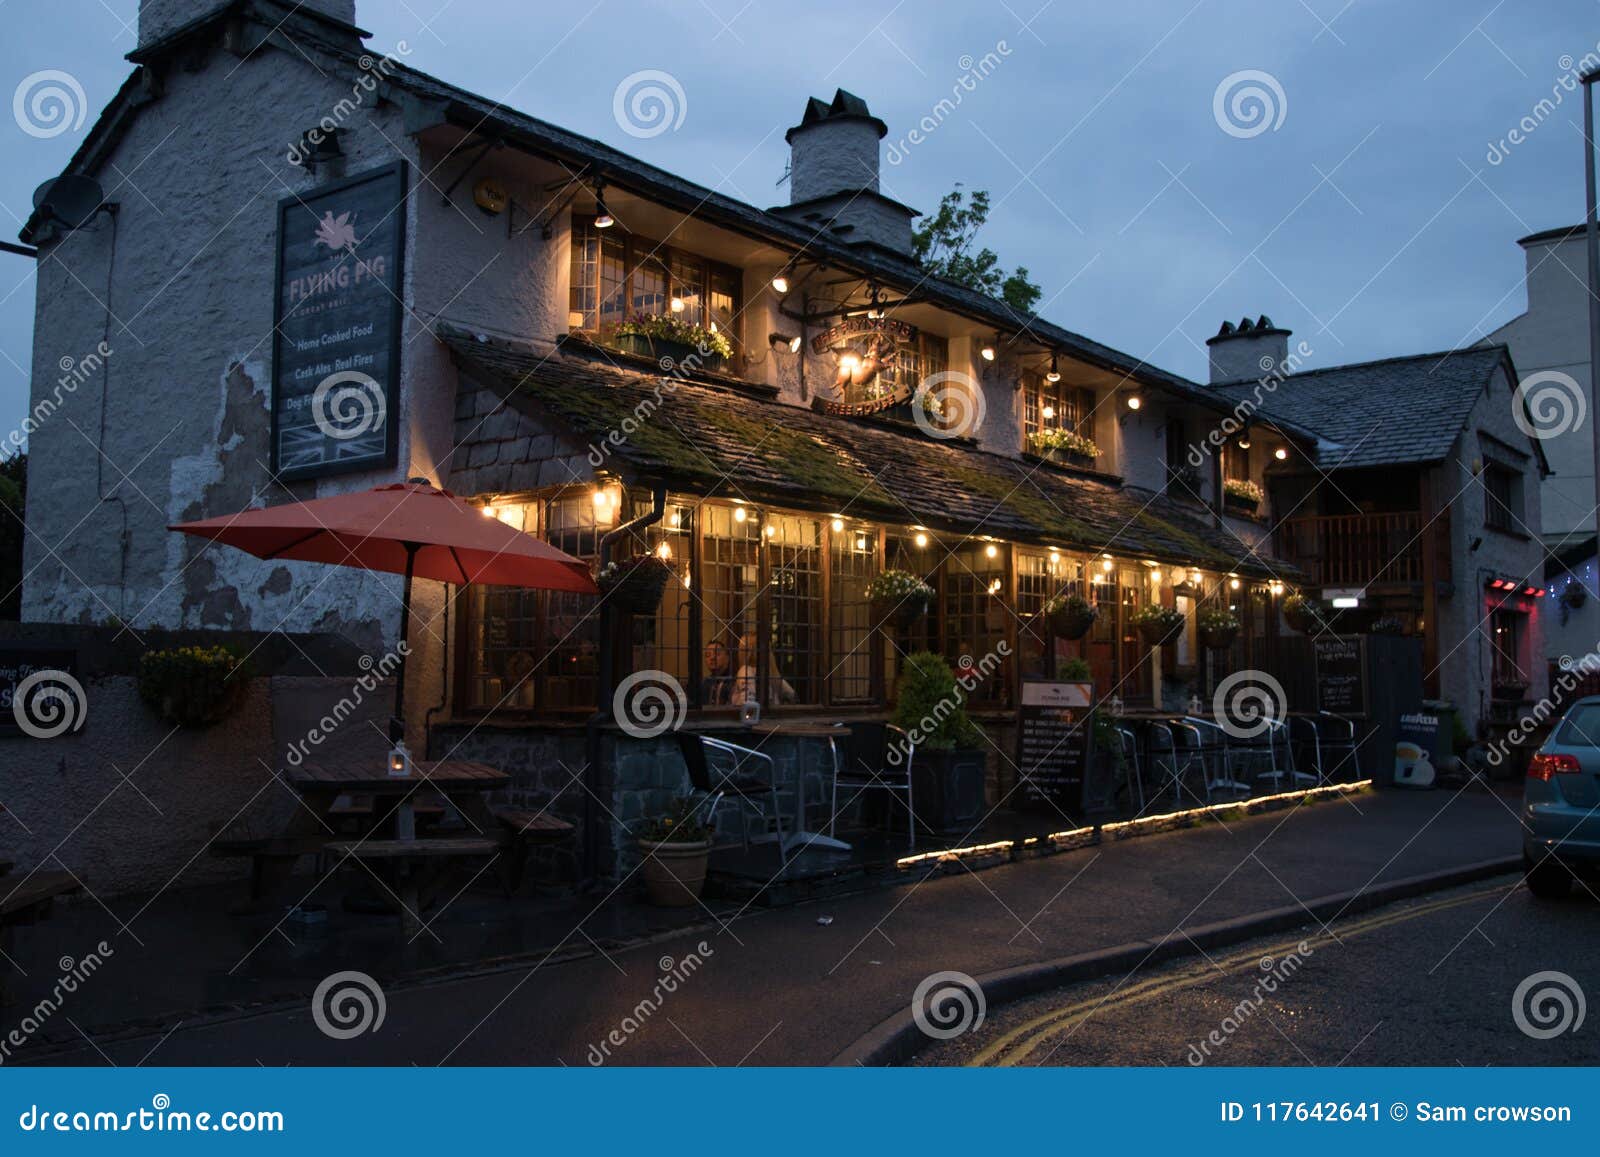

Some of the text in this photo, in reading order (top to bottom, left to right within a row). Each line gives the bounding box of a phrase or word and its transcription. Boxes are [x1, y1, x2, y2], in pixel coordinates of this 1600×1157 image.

[289, 255, 385, 301] FLYING PIG
[297, 322, 374, 351] Home Cooked Food
[335, 355, 352, 371] Real
[354, 353, 374, 367] Fires
[287, 398, 302, 411] Dog
